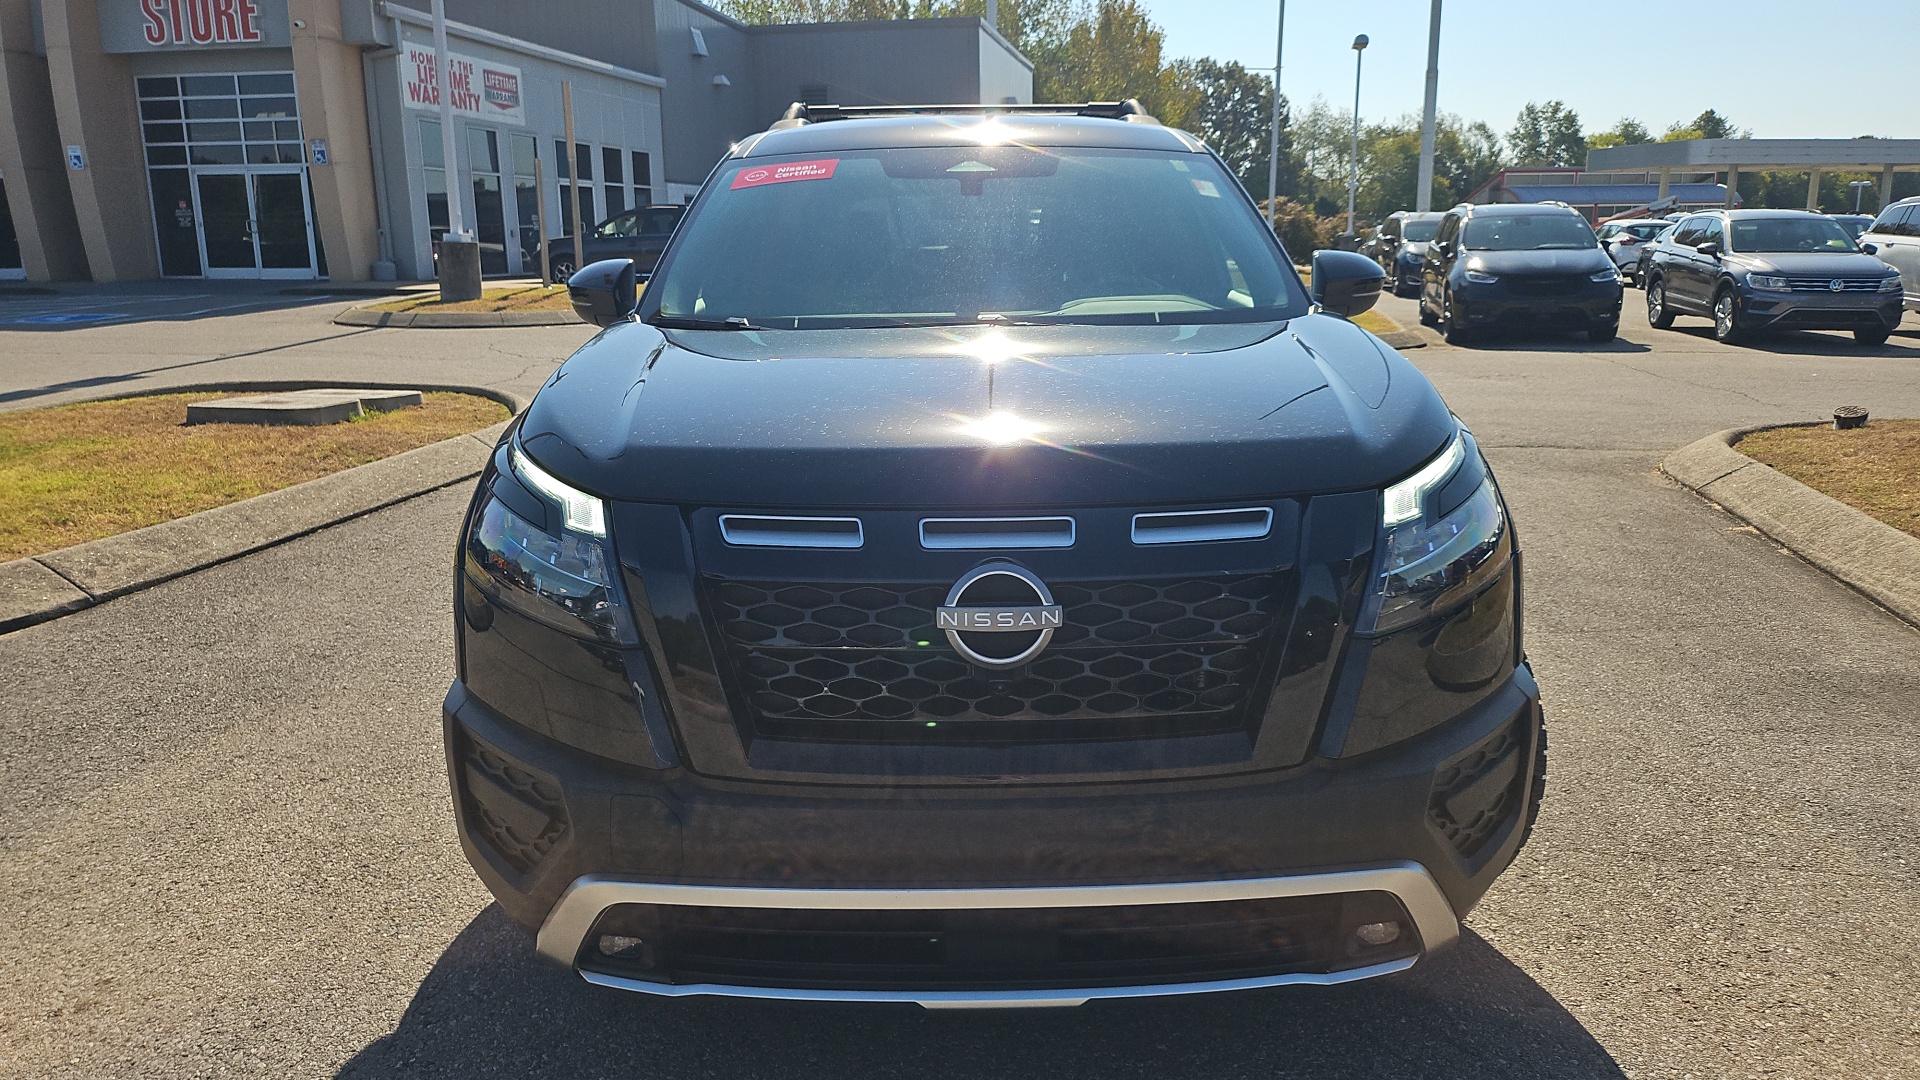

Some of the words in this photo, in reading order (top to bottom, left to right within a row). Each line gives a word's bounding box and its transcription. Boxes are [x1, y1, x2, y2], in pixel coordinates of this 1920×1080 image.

[140, 0, 261, 46] STORE
[457, 61, 474, 75] THE
[484, 71, 518, 92] LIFETIME
[408, 81, 481, 113] WARANTY
[774, 168, 826, 178] Certified
[777, 164, 817, 173] Nissan
[940, 609, 1060, 628] NISSAN
